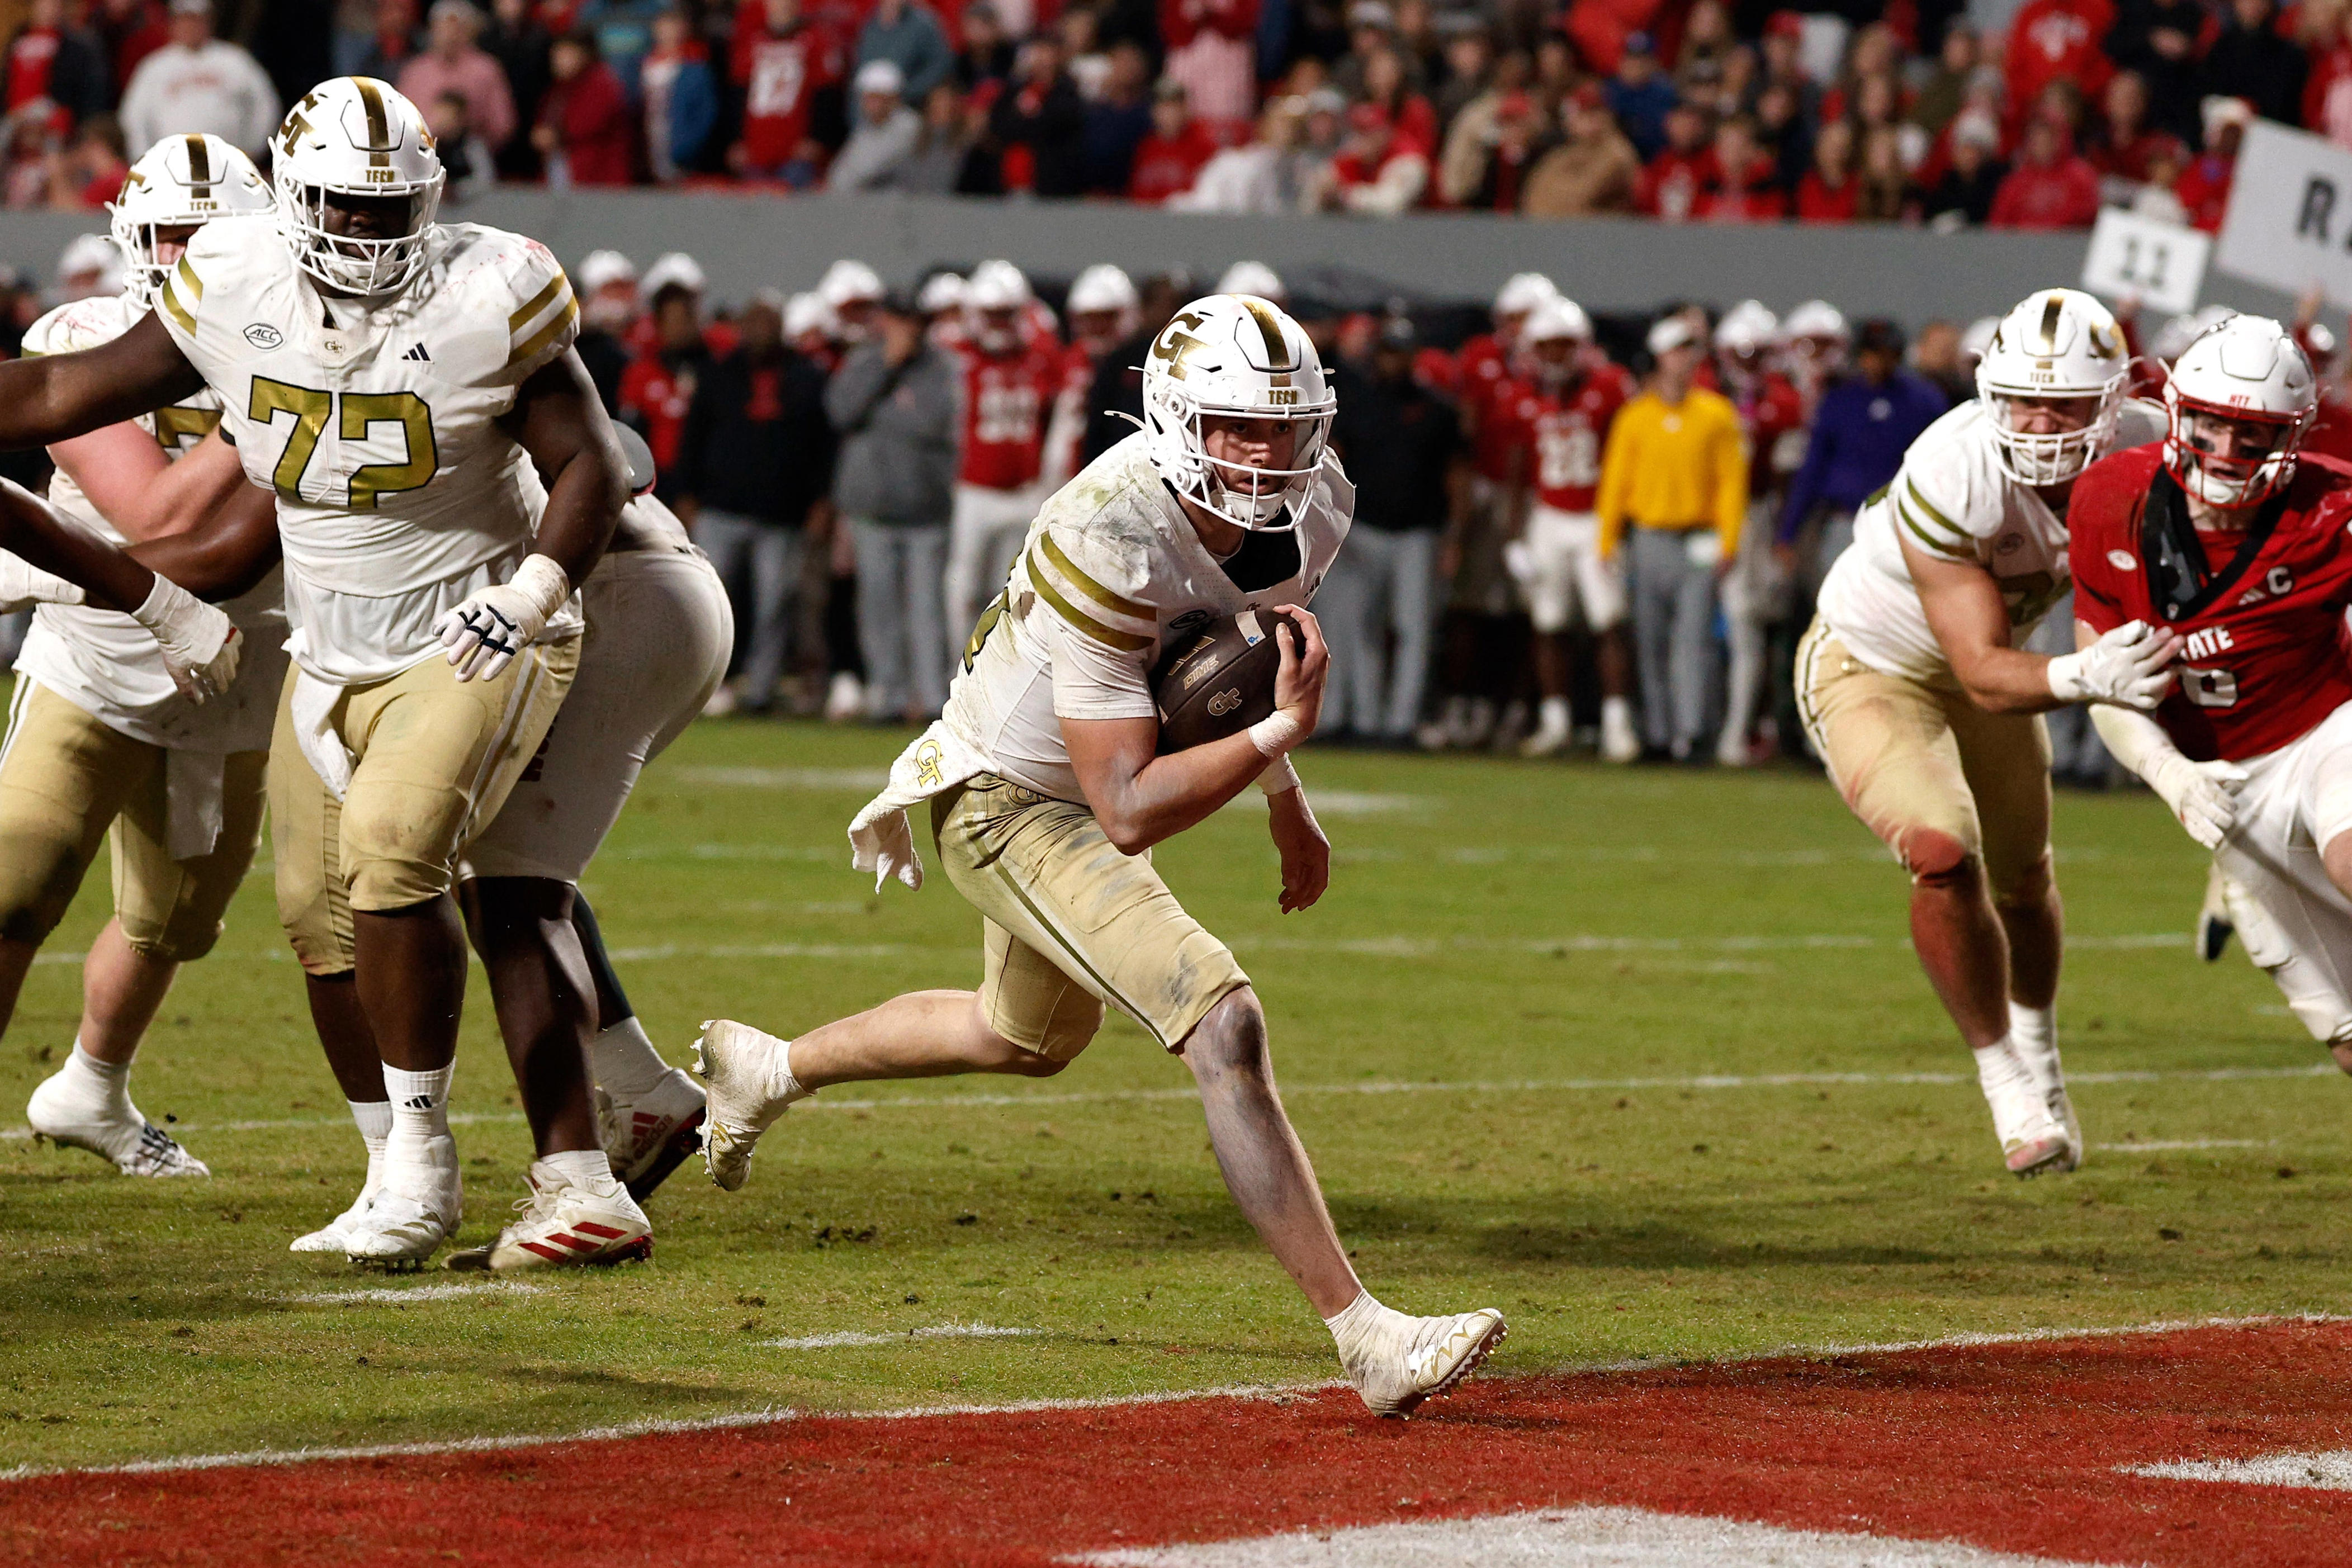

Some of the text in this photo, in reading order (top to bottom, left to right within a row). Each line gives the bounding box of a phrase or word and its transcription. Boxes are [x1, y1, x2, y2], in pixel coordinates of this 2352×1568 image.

[365, 169, 395, 183] TECH
[190, 201, 217, 211] TECH
[2297, 176, 2352, 253] R
[249, 328, 277, 342] ACC
[1153, 312, 1214, 382] GT
[1268, 390, 1298, 405] TECH
[248, 374, 439, 509] 72
[2266, 566, 2293, 595] C
[2179, 624, 2235, 661] ATE
[1206, 687, 1243, 717] GT
[916, 738, 944, 788] GT
